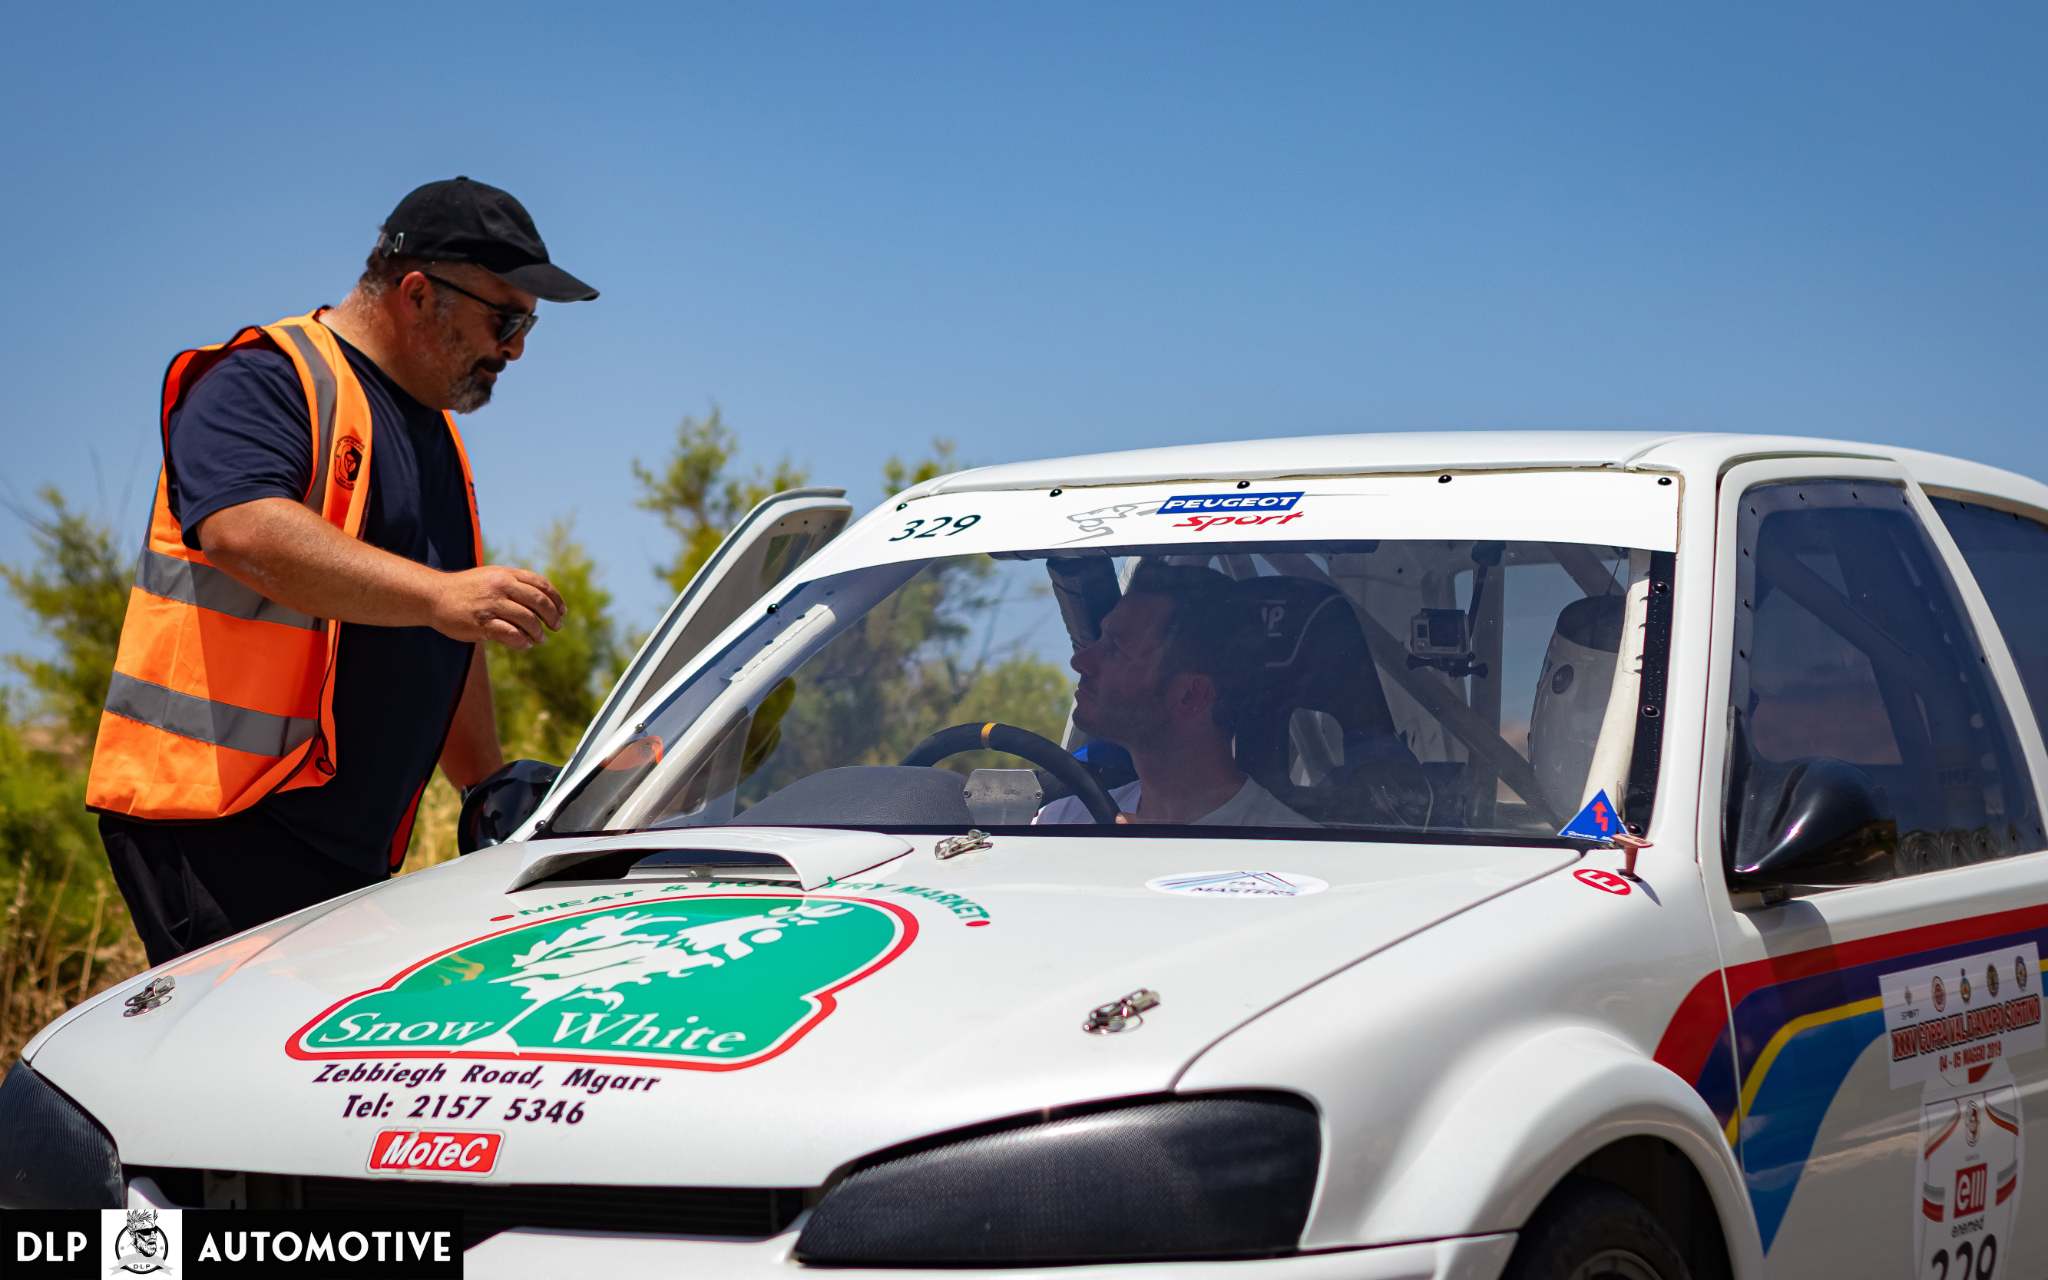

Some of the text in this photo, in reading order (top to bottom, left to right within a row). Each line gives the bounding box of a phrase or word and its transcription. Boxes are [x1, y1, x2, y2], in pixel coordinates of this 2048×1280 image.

[1163, 496, 1297, 510] PEUGEOT
[888, 514, 982, 541] 329
[1172, 511, 1304, 531] Sport
[518, 889, 644, 916] MEAT
[890, 885, 991, 919] MARKET
[317, 1012, 747, 1053] Snow White
[312, 1062, 661, 1094] Zebbiegh Road, Mgarr
[343, 1092, 586, 1125] Tel: 2157 5346
[380, 1134, 489, 1169] MoTeC
